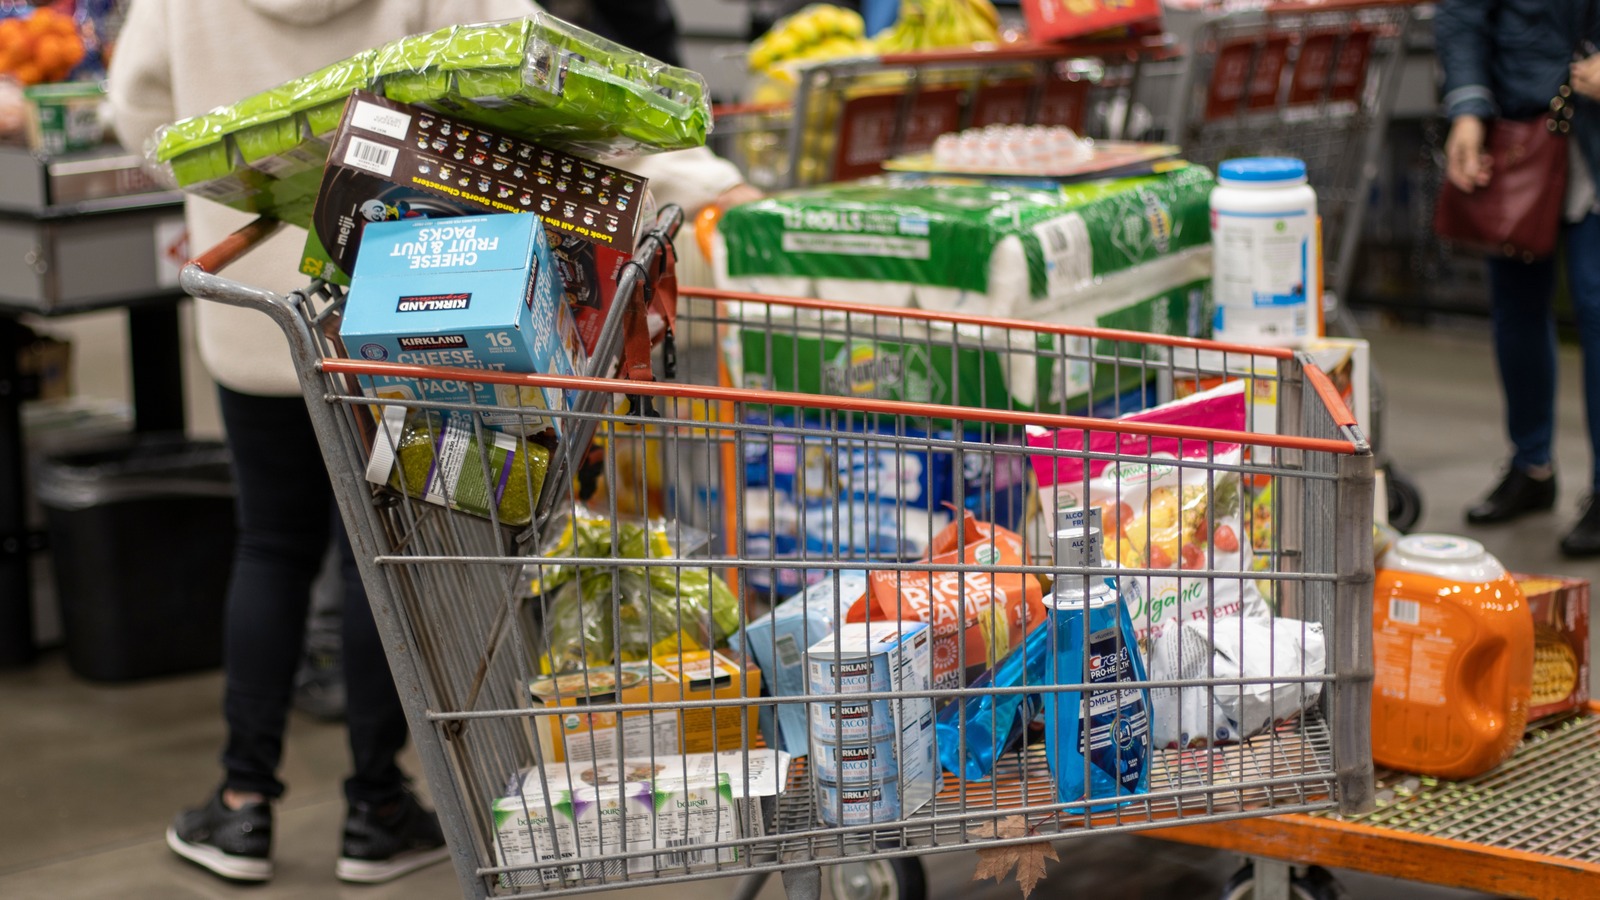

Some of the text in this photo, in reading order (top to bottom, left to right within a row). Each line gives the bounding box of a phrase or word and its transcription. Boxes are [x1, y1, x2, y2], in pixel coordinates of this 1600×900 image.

[412, 176, 519, 215] Panda Sports Characters
[337, 215, 355, 246] meiji
[418, 226, 477, 242] PACKS
[545, 217, 613, 244] Look for All the
[390, 236, 499, 257] FRUIT & NUT
[303, 256, 323, 276] 32
[408, 251, 478, 269] CHEESE,
[399, 299, 468, 312] KIRKLAND
[401, 336, 464, 346] KIRKLAND
[485, 332, 512, 347] 16
[416, 379, 484, 395] PACKS
[1066, 510, 1097, 520] ALCOOL
[1072, 536, 1096, 547] ALCOL
[1080, 546, 1093, 554] FE
[902, 571, 992, 609] RICE
[1191, 600, 1245, 622] Bend
[931, 619, 973, 636] OODLS
[832, 661, 873, 673] KRKLAN
[830, 674, 878, 686] ABACOE
[1083, 690, 1123, 708] OMPLEE
[831, 705, 871, 715] KRKLAN
[829, 717, 877, 728] ABACOE
[834, 748, 875, 757] RKLAN
[833, 760, 878, 770] ABACOE
[842, 789, 880, 799] IRKLAD
[677, 797, 708, 809] boursin
[748, 798, 757, 822] Nutrition
[517, 815, 550, 826] boursin
[541, 852, 574, 861] BOUSIN
